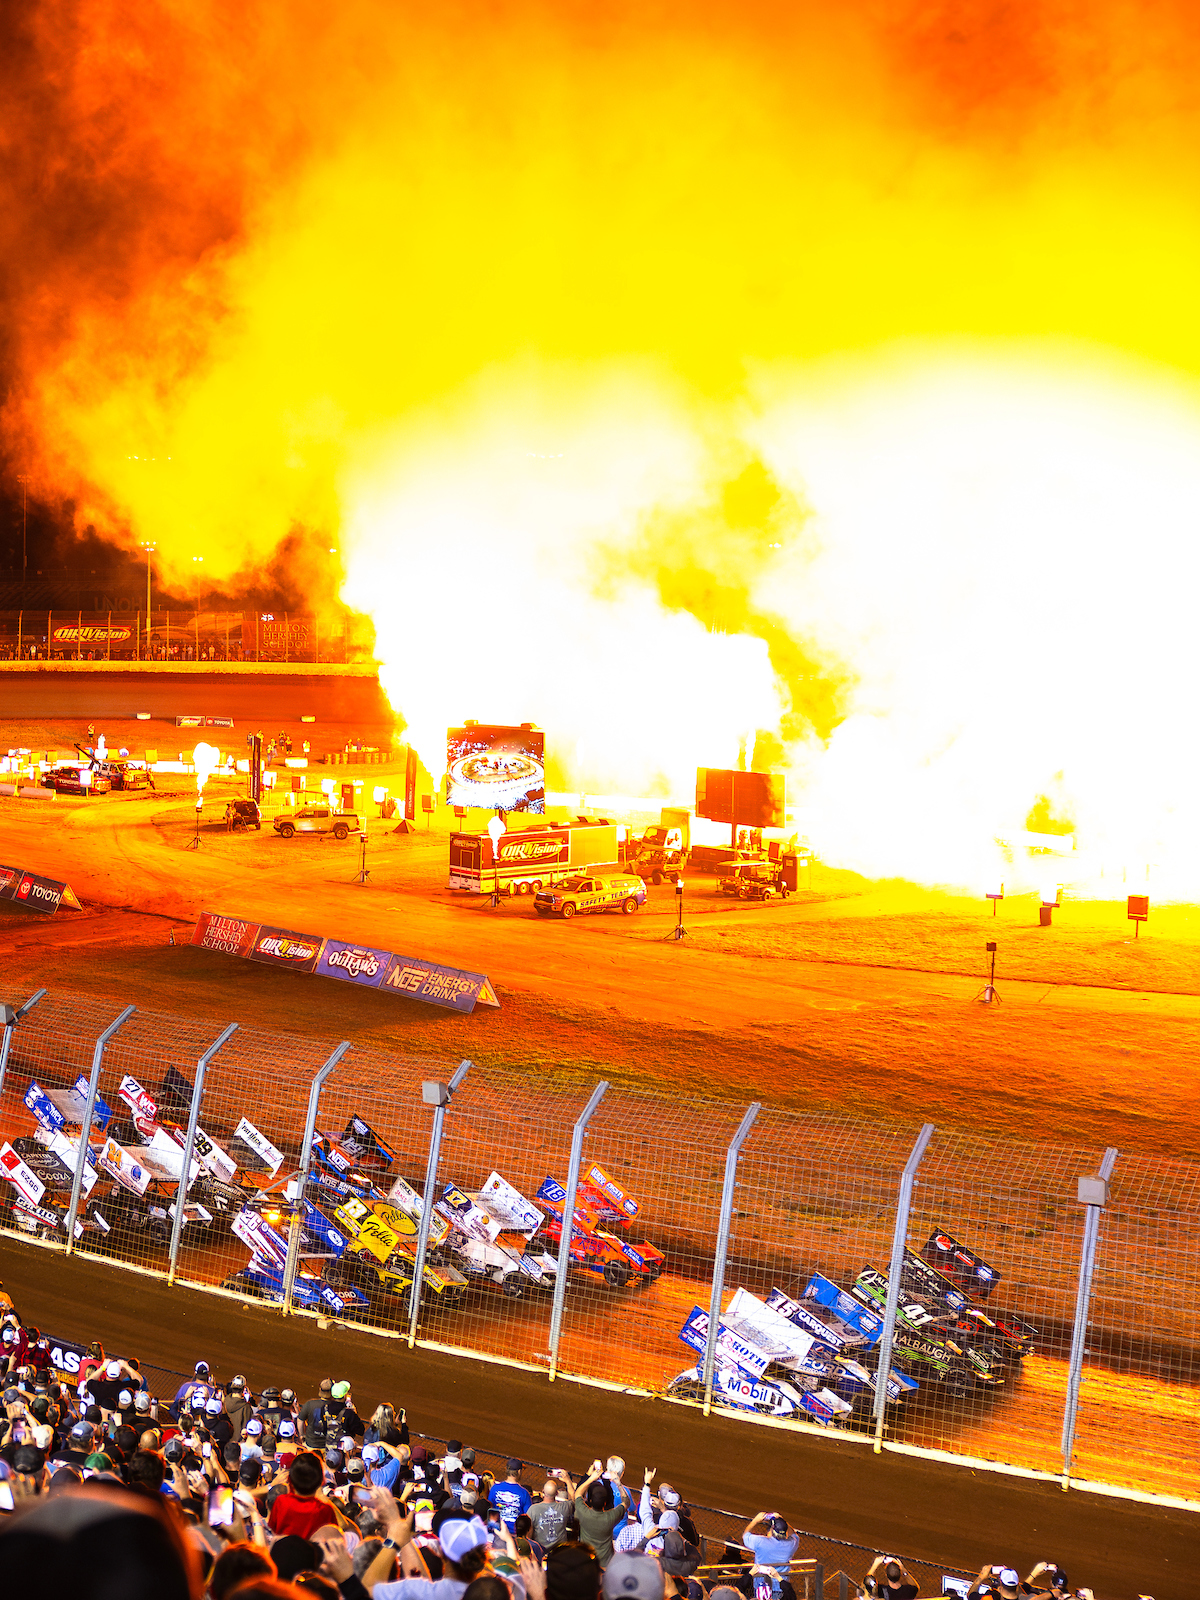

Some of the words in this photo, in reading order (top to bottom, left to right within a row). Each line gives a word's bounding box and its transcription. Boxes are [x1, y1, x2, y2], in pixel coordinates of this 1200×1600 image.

[263, 623, 309, 632] MILTON
[263, 632, 309, 640] HERSHEY
[263, 641, 309, 649] SCHOOL
[31, 885, 60, 904] TOYOTA
[580, 896, 606, 908] SAFETY
[208, 915, 249, 932] MILTON
[205, 926, 245, 944] HERSHEY
[201, 937, 239, 954] SCHOOL
[386, 965, 429, 992] NOS
[427, 973, 478, 994] ENERGY
[421, 985, 462, 1002] DRINK
[327, 1149, 351, 1171] NOS
[319, 1173, 341, 1188] NOS
[445, 1190, 469, 1208] 17
[542, 1184, 568, 1202] 18
[343, 1196, 368, 1219] 13
[240, 1209, 262, 1231] 26
[363, 1221, 393, 1247] Pella
[337, 1291, 357, 1299] ORD
[875, 1276, 908, 1303] ALBGH
[766, 1293, 800, 1318] 15
[797, 1311, 846, 1347] CARQUEST
[902, 1304, 934, 1327] 41
[732, 1341, 767, 1368] ROTH
[898, 1335, 951, 1362] ALBAUGH
[801, 1356, 847, 1376] FORD
[727, 1377, 768, 1402] Mobil
[873, 1372, 900, 1392] CRB
